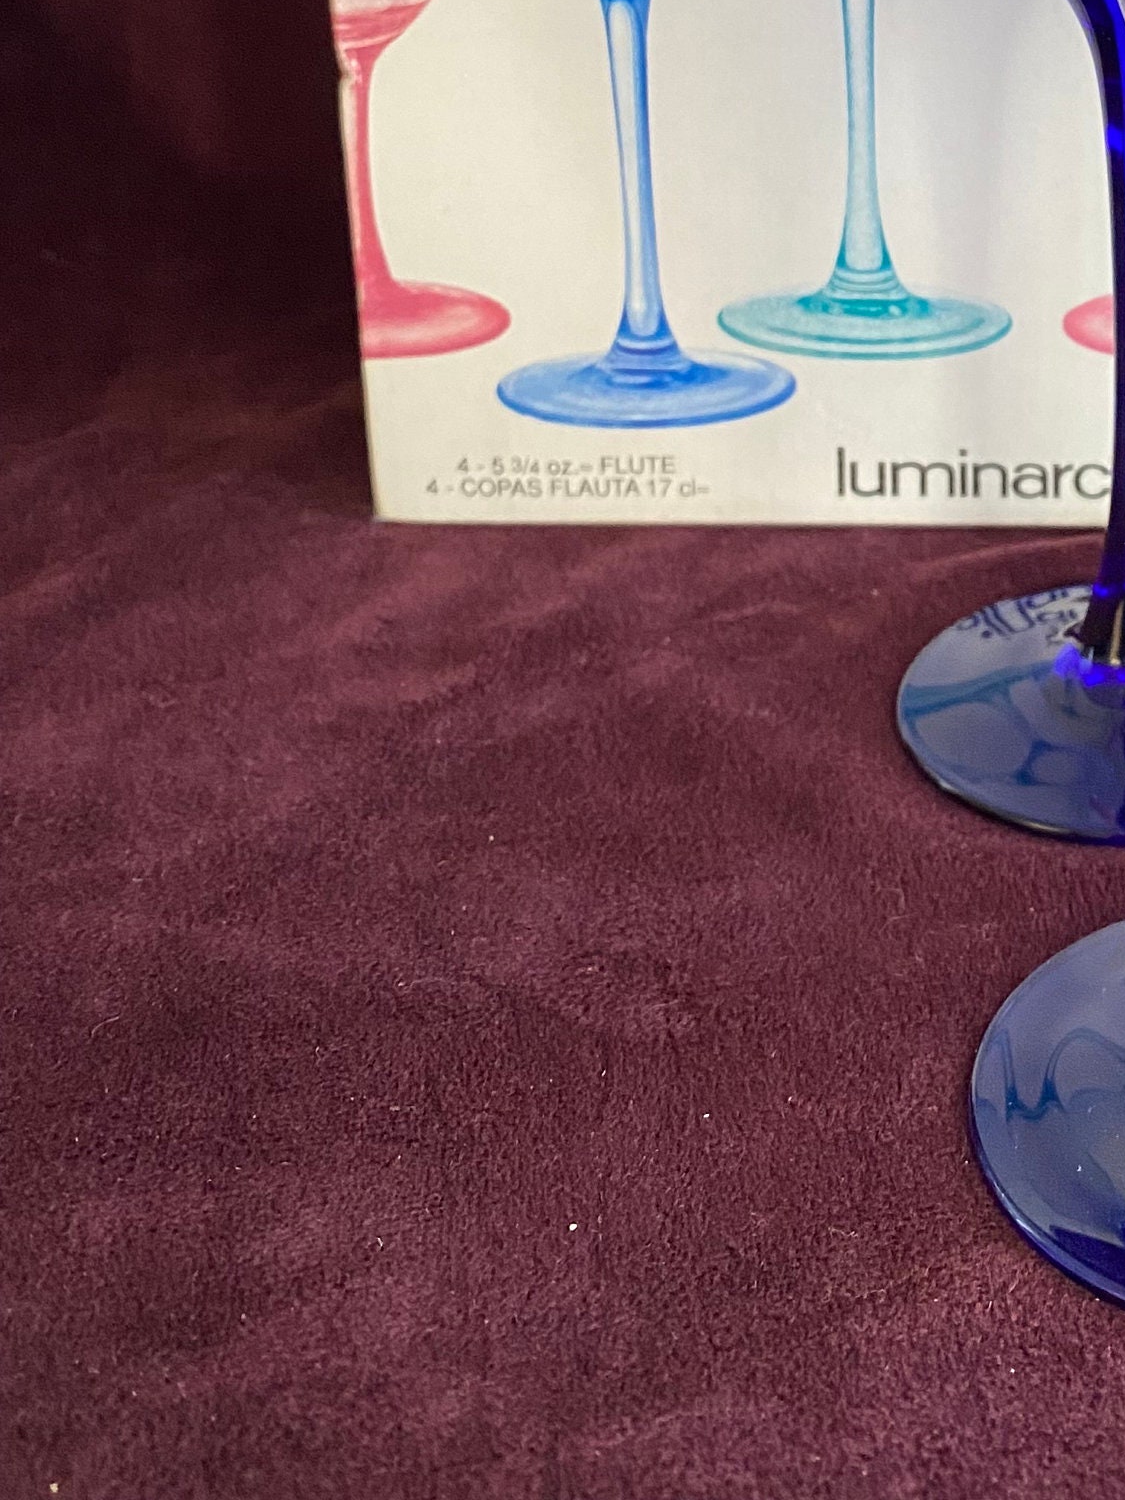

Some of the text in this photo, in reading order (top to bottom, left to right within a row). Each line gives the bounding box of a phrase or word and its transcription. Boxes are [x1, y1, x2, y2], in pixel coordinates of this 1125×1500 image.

[457, 457, 469, 472] 4
[492, 455, 505, 475] 5
[510, 455, 540, 475] 3/4
[600, 454, 676, 475] FLUTE
[837, 446, 1111, 499] luminarc
[426, 478, 438, 493] 4
[460, 476, 543, 498] COPAS
[550, 477, 640, 497] FLAUTA
[647, 477, 672, 497] 17
